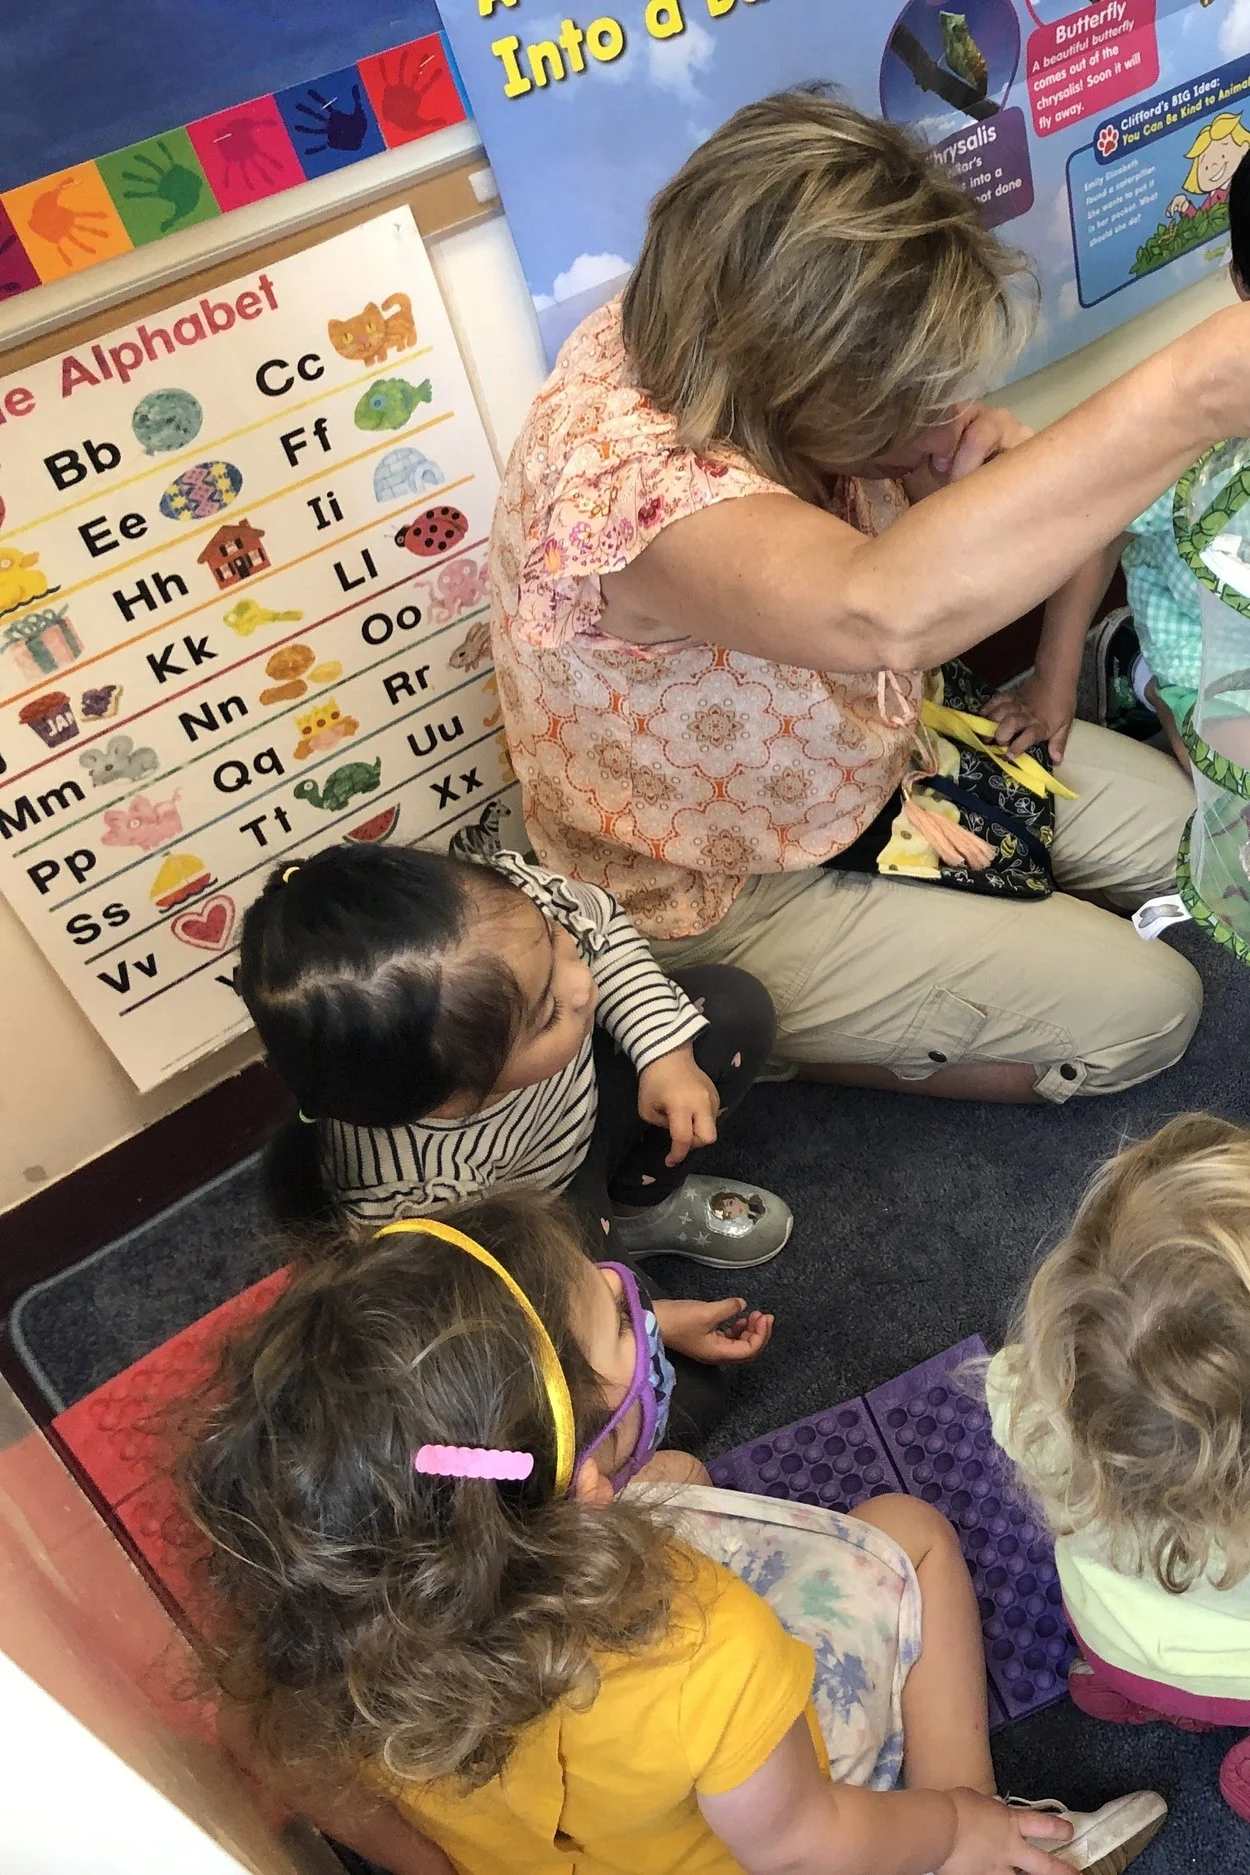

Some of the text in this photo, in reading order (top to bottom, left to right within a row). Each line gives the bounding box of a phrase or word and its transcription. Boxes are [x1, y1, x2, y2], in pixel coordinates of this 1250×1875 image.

[491, 0, 684, 98] Into a
[1032, 19, 1135, 73] A beautiful butterfly
[1056, 1, 1127, 44] Butterfly
[1033, 45, 1119, 91] comes out of the
[1036, 51, 1141, 110] chrysalis! Soon it will
[1120, 77, 1221, 131] Clifford's BIG Idea:
[933, 125, 997, 164] hrysalis
[1039, 101, 1085, 130] fly away.
[1121, 129, 1140, 146] You
[1143, 120, 1164, 136] Can
[1165, 113, 1178, 126] Be
[1180, 100, 1203, 118] Kind
[1205, 93, 1216, 106] to
[969, 172, 992, 188] into
[994, 167, 1003, 178] a
[995, 178, 1022, 197] done
[61, 274, 281, 398] Alphabet
[43, 353, 325, 491] Bb Cc
[77, 418, 332, 558] Ee Ff
[112, 496, 344, 622] Hh Ii
[146, 548, 378, 684] Kk Ll
[0, 605, 422, 840] Mm Nn Oo
[26, 665, 430, 895] Pp Qq Rr
[65, 713, 465, 946] Ss Tt Uu
[96, 767, 485, 994] Vv Xx
